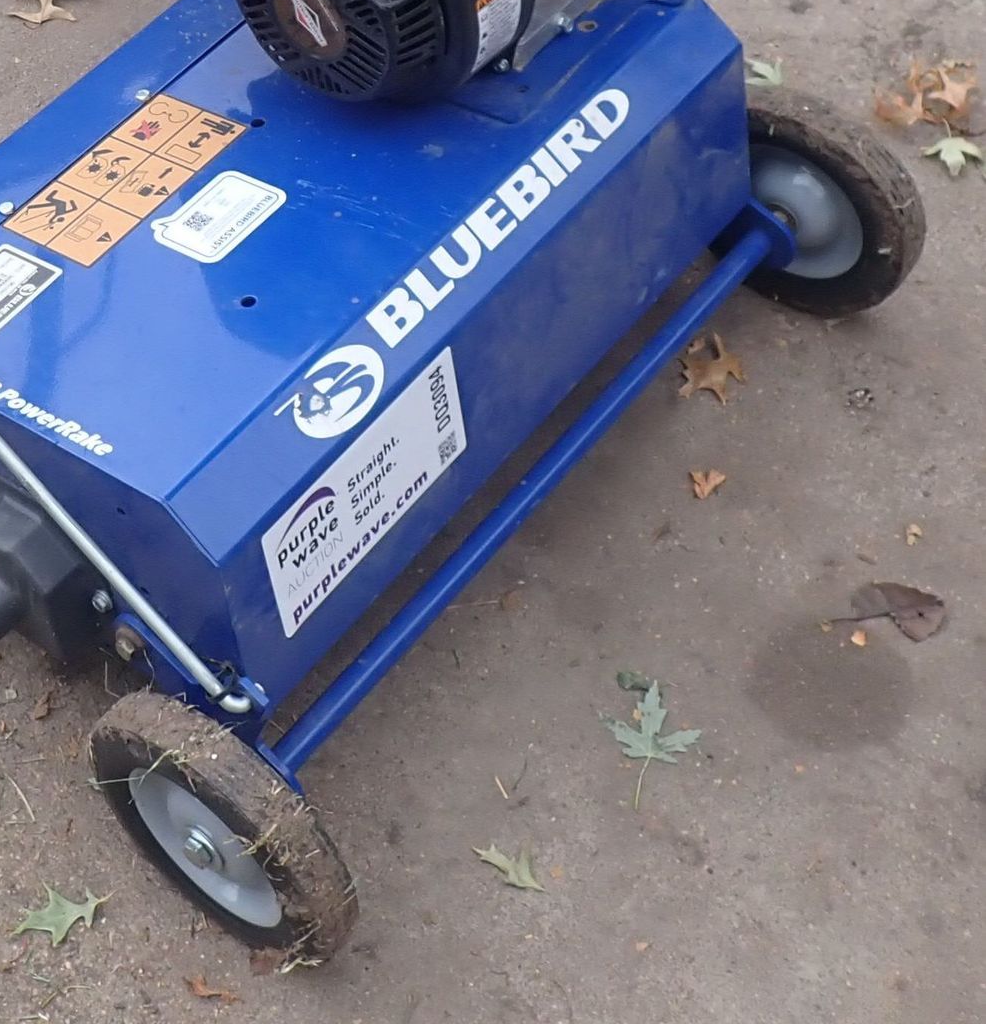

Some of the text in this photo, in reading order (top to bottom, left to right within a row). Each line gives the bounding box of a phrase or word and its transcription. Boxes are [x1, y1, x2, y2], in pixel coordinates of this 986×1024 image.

[236, 194, 274, 227] BLUEBIRD
[365, 88, 630, 349] BLUEBIRD
[211, 226, 236, 251] ASSIST
[347, 436, 400, 493] Straight.
[351, 461, 397, 510] Simple.
[277, 498, 336, 569] purple
[354, 493, 386, 526] Sold.
[286, 531, 345, 601] AUCTION
[292, 516, 340, 569] wave
[293, 470, 428, 625] purplewave.com
